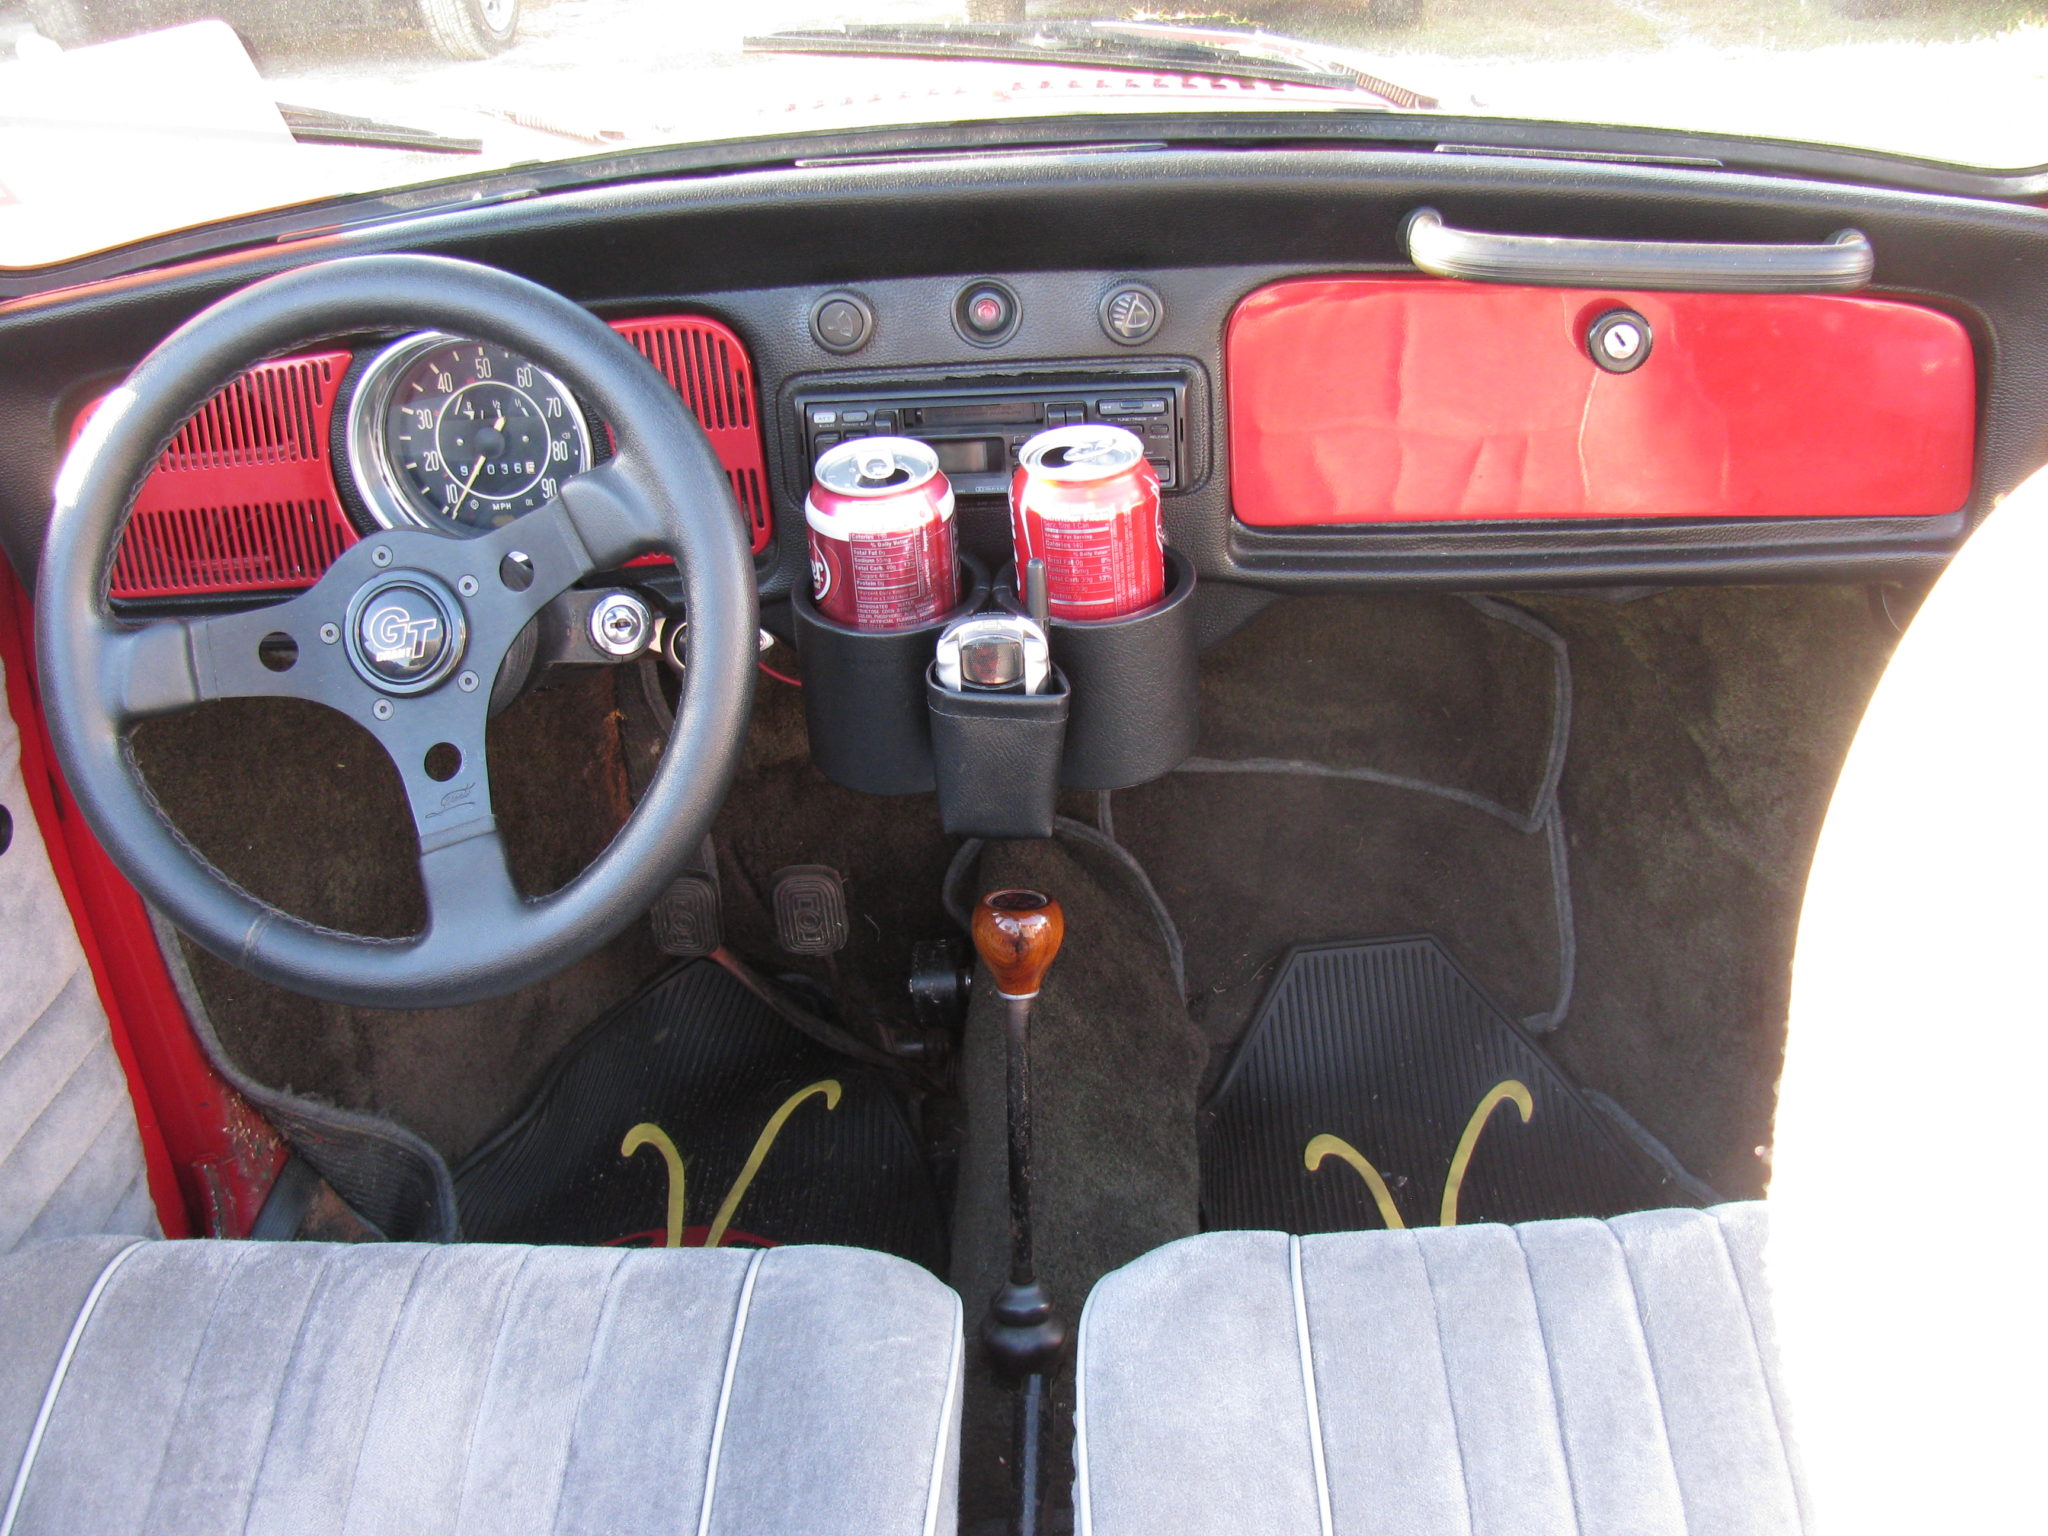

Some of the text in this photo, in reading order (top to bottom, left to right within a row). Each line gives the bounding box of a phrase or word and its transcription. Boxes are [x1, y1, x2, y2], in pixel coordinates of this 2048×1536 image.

[475, 359, 492, 379] 50
[517, 367, 532, 388] 60
[437, 373, 453, 393] 40
[546, 397, 562, 418] 70
[417, 409, 433, 430] 30
[552, 440, 568, 461] 80
[424, 451, 440, 472] 20
[446, 484, 459, 504] 10
[541, 478, 558, 499] 90
[492, 502, 512, 511] MPH
[525, 498, 534, 507] OIL
[1045, 540, 1071, 548] Calories
[1047, 556, 1062, 564] Total
[1075, 559, 1084, 567] 0g
[370, 606, 437, 659] GT
